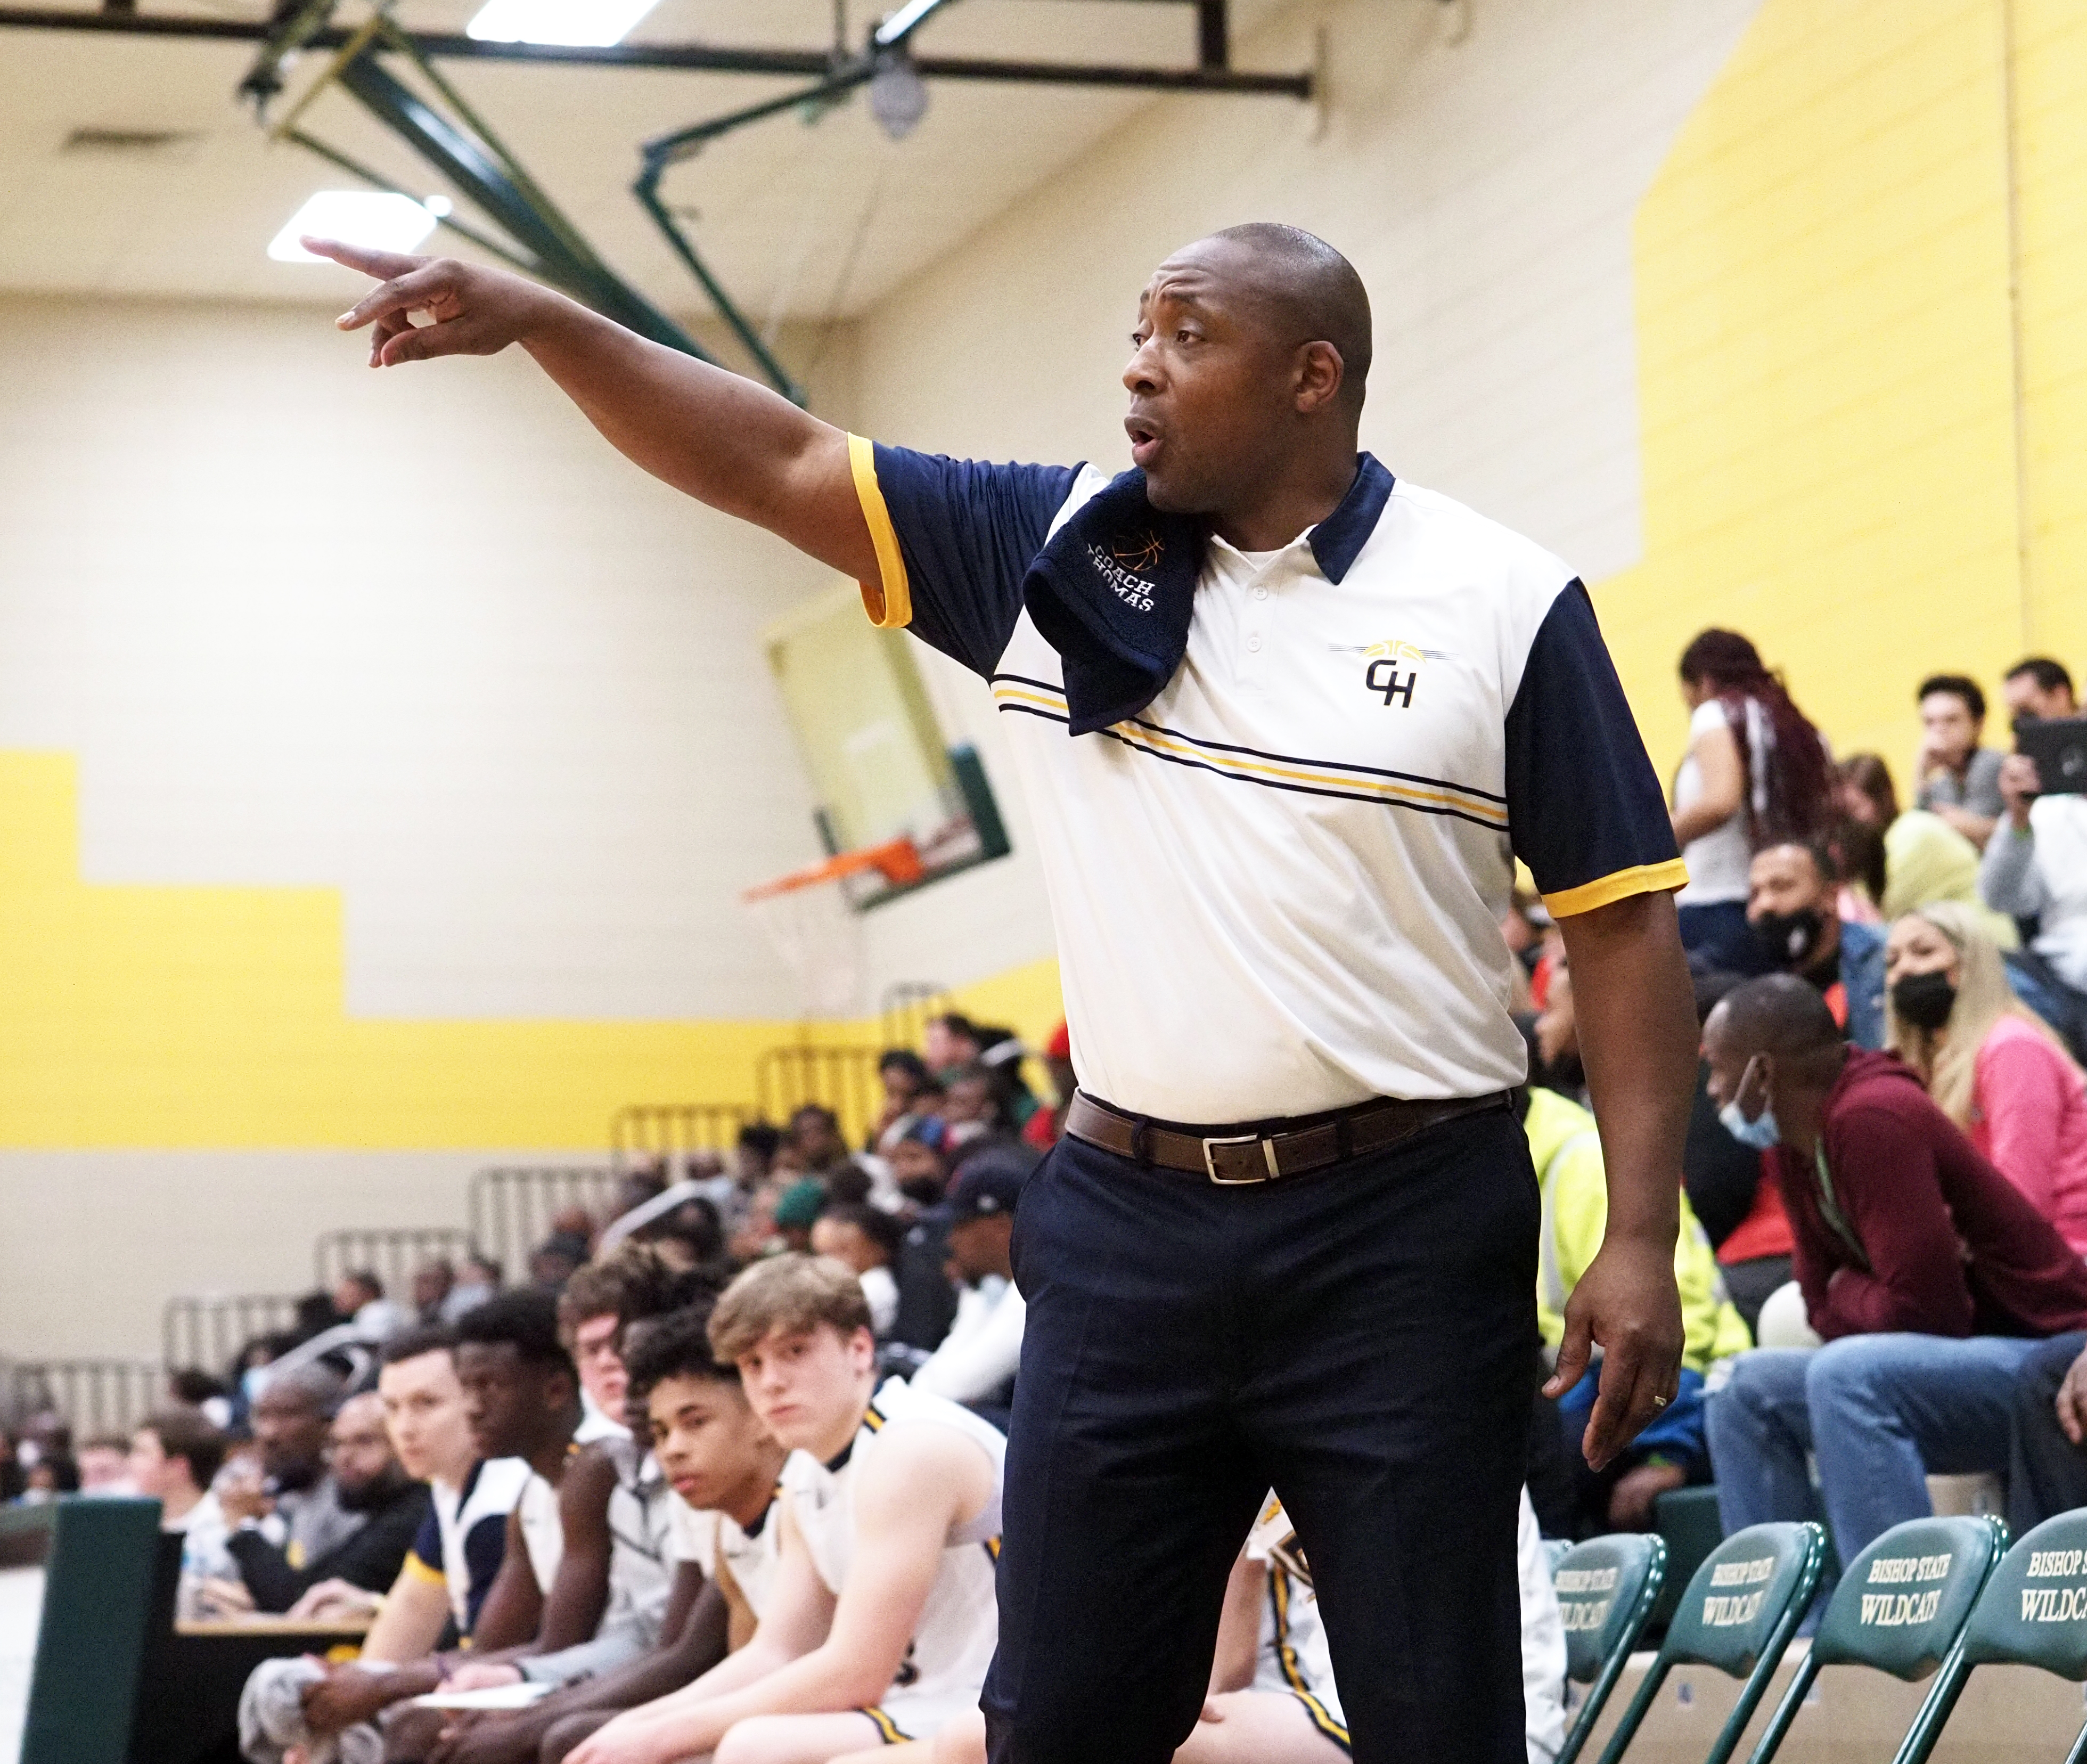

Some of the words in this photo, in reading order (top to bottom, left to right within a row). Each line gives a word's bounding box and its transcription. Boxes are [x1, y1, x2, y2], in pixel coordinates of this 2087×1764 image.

[1095, 545, 1155, 596] COACH
[1365, 659, 1417, 708] CH
[1867, 1557, 1918, 1583] BISHOP
[1916, 1553, 1952, 1582] STATE
[2026, 1549, 2083, 1577] BISHOP
[1861, 1589, 1942, 1626] WILDCATS
[2021, 1587, 2087, 1622] WILDC
